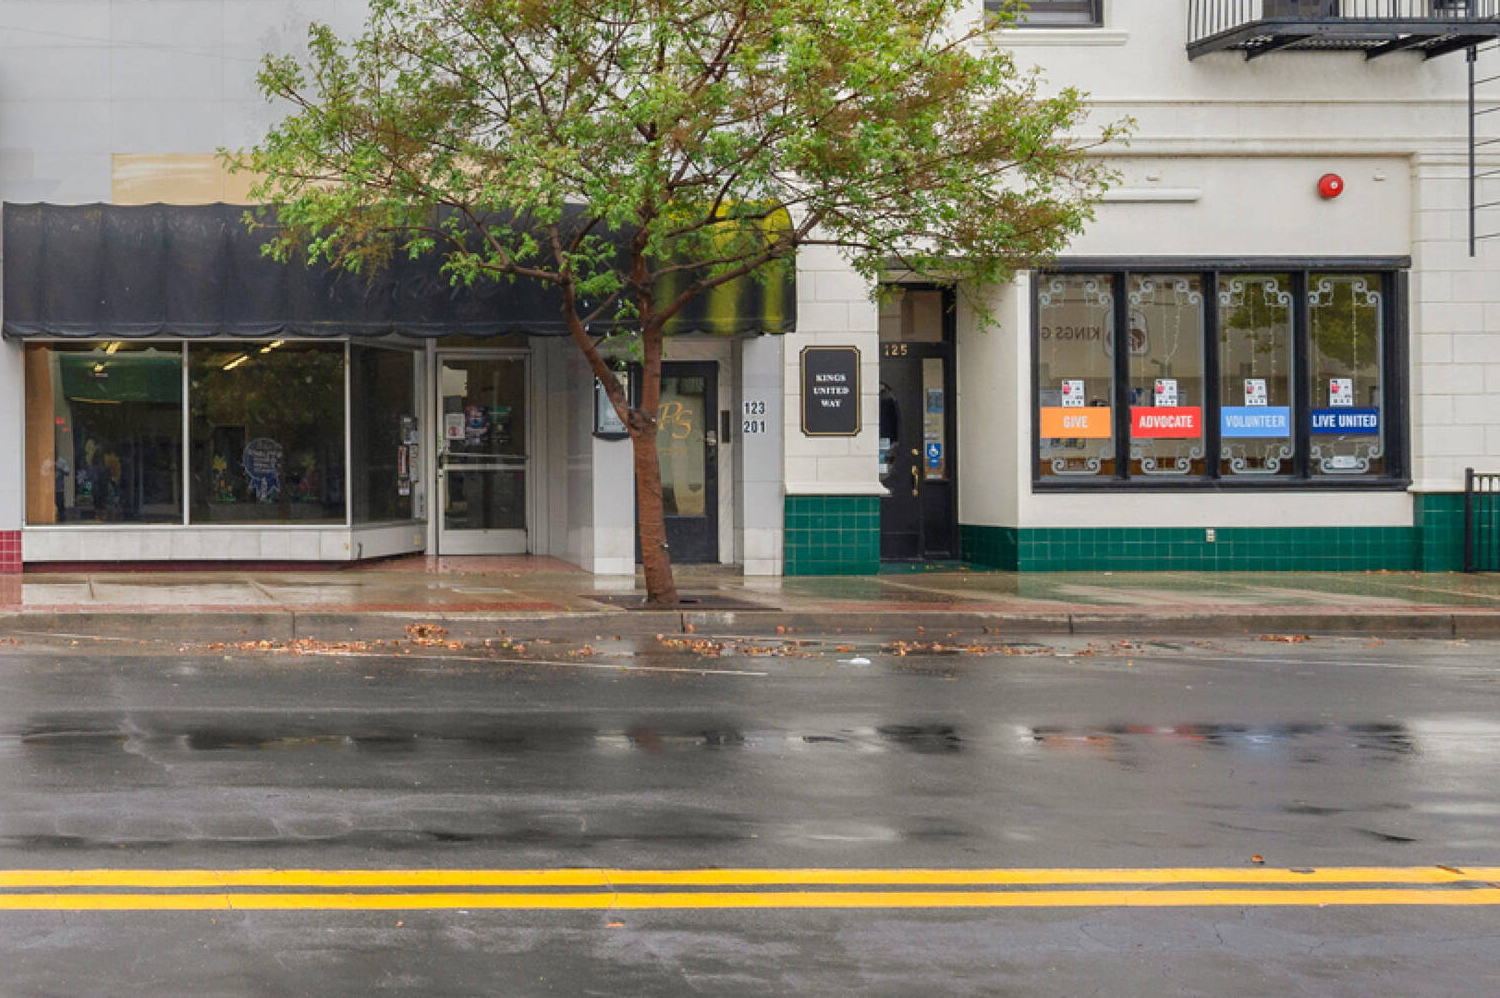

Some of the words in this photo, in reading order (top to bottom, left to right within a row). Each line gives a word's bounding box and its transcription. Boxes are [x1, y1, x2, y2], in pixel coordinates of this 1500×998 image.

[884, 344, 908, 356] 125
[815, 374, 847, 382] KINGS
[813, 387, 850, 395] UNITED
[745, 401, 766, 415] 123
[821, 400, 842, 408] WAY
[743, 421, 766, 434] 201
[1063, 415, 1088, 428] GIVE
[1139, 415, 1193, 428] ADVOCATE
[1225, 415, 1285, 428] VOLUNTEER
[1312, 414, 1336, 428] LIVE
[1338, 414, 1377, 428] UNITED
